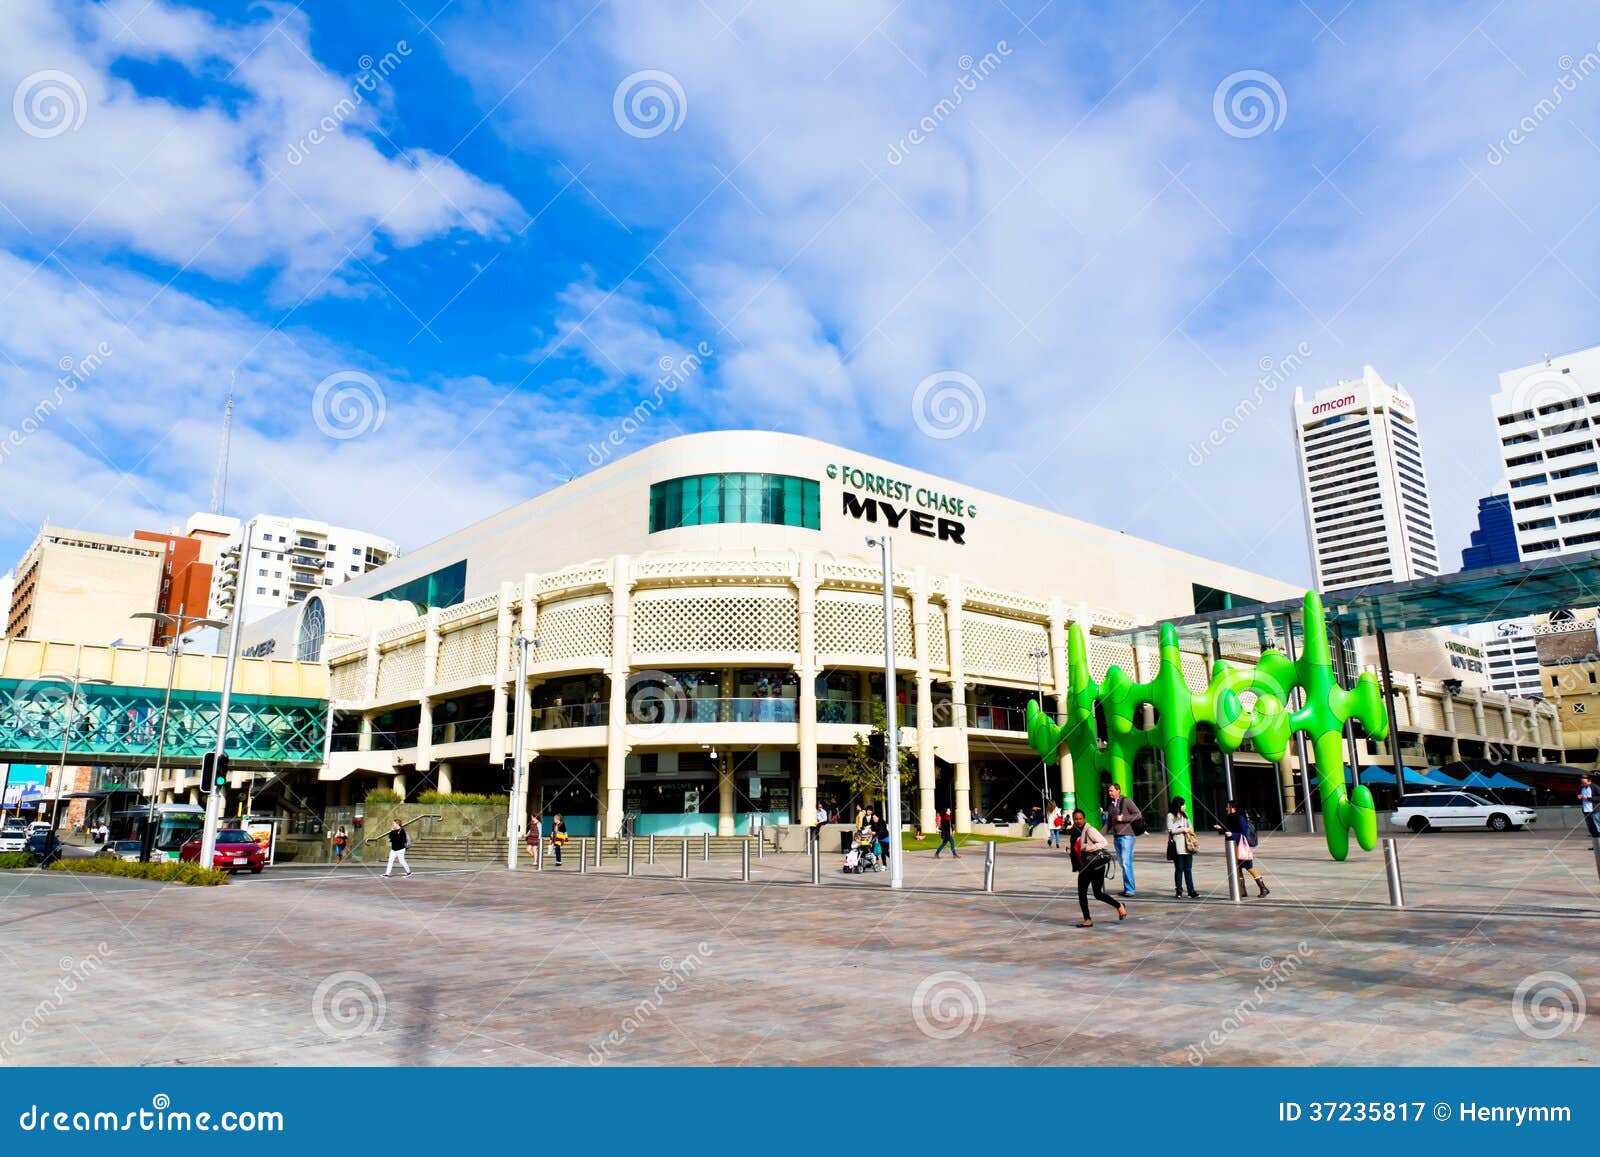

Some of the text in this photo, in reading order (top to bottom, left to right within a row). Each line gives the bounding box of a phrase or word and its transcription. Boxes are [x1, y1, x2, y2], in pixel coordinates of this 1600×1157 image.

[1312, 394, 1356, 415] amcom
[842, 465, 965, 517] FORREST CHASE
[843, 491, 966, 545] MYER
